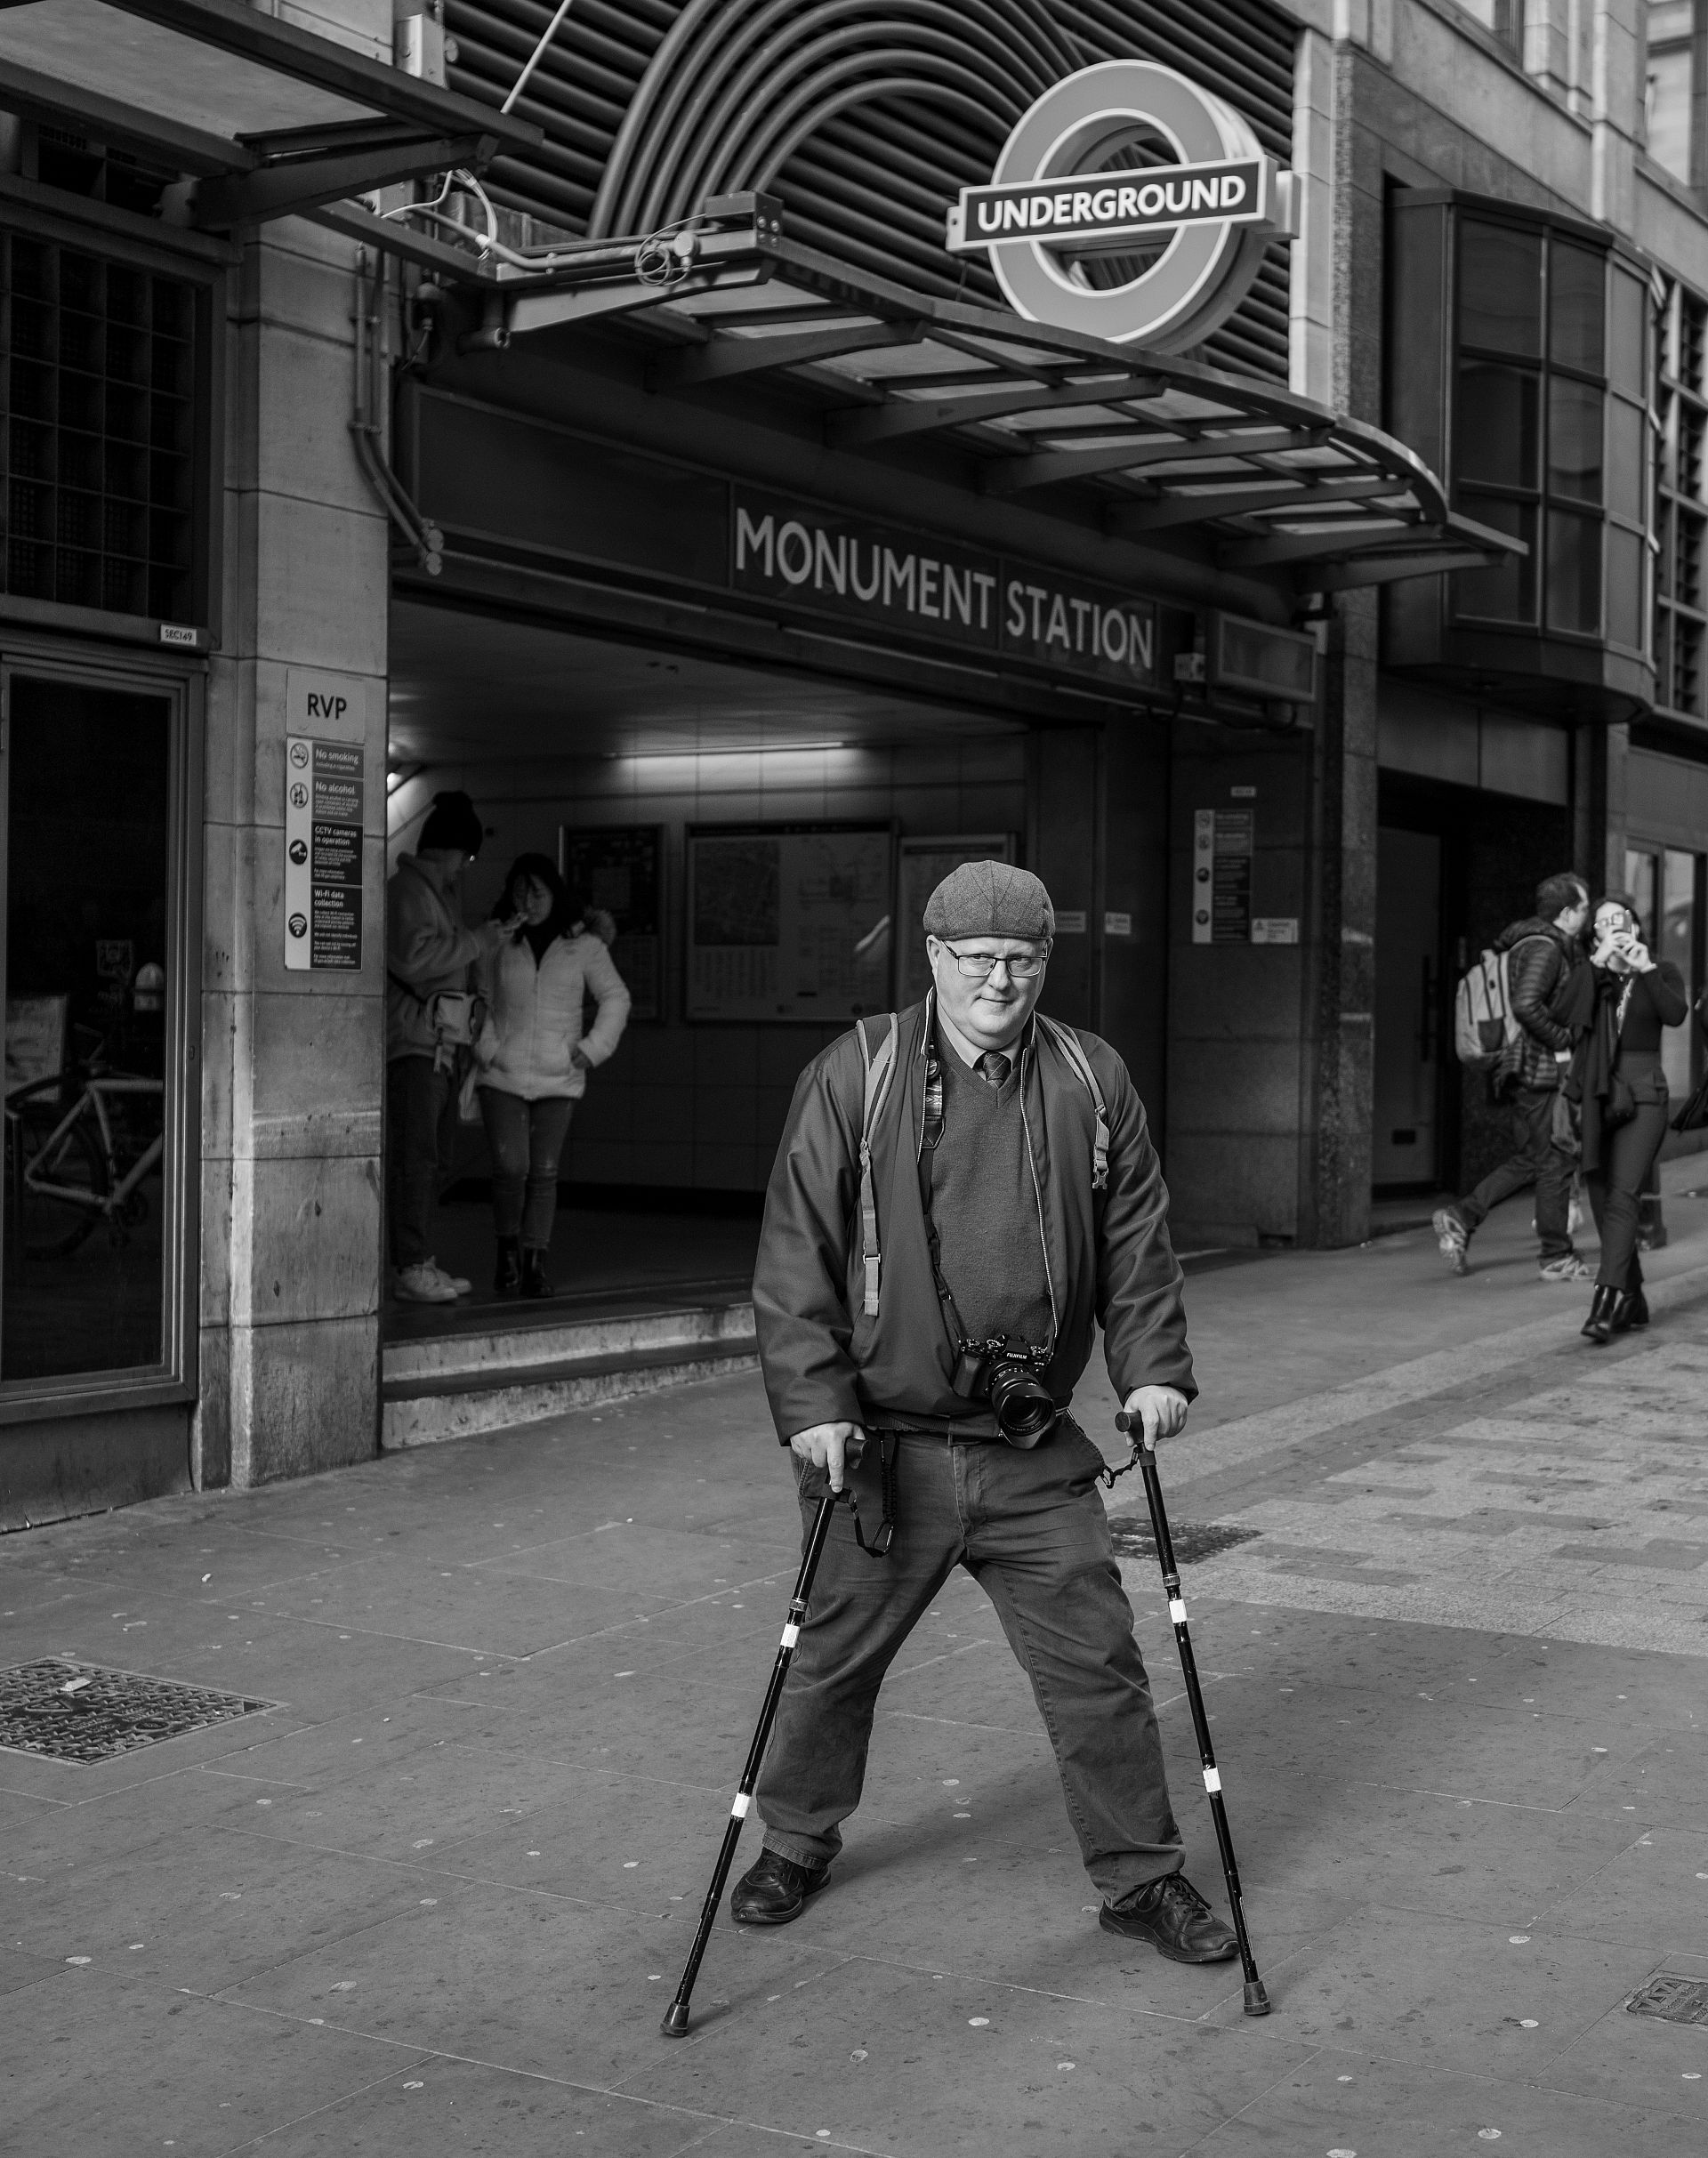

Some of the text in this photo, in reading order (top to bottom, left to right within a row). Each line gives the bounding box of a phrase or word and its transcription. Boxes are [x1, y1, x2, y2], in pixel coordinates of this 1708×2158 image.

[979, 175, 1246, 231] UNDERGROUND
[736, 507, 1153, 670] MONUMENT STATION
[307, 692, 347, 720] RVP
[316, 749, 359, 765] No smoking
[316, 781, 355, 795] No alcohol
[314, 825, 357, 838] CCTV cameras
[314, 835, 350, 846] in operation
[330, 890, 344, 899] data
[313, 898, 343, 908] collection
